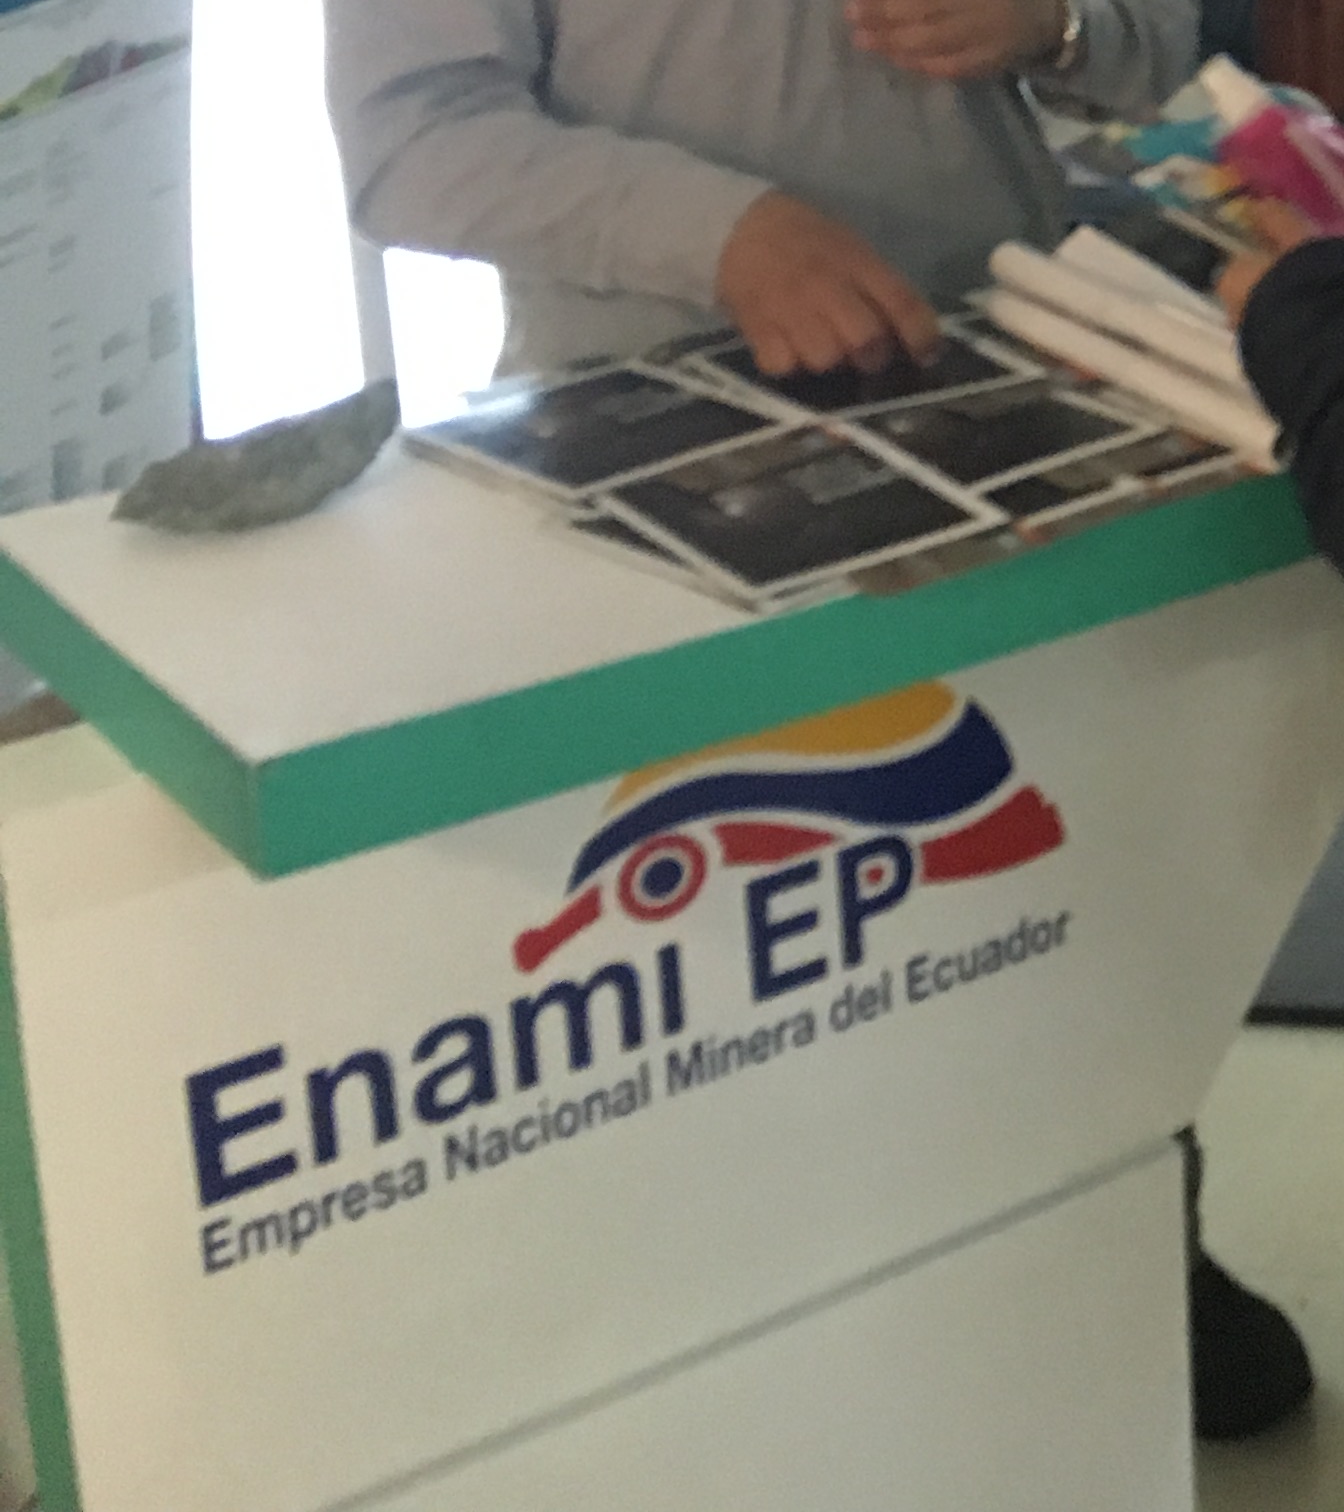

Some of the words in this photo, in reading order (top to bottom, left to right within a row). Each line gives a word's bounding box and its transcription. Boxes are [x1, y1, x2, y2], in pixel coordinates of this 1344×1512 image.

[185, 942, 686, 1210] Enami
[744, 834, 914, 1003] EP
[200, 1156, 428, 1276] Empresa
[443, 1061, 653, 1181] Nacional
[664, 1008, 816, 1097] Minera
[828, 968, 893, 1034] del
[904, 910, 1070, 1004] Ecuador
